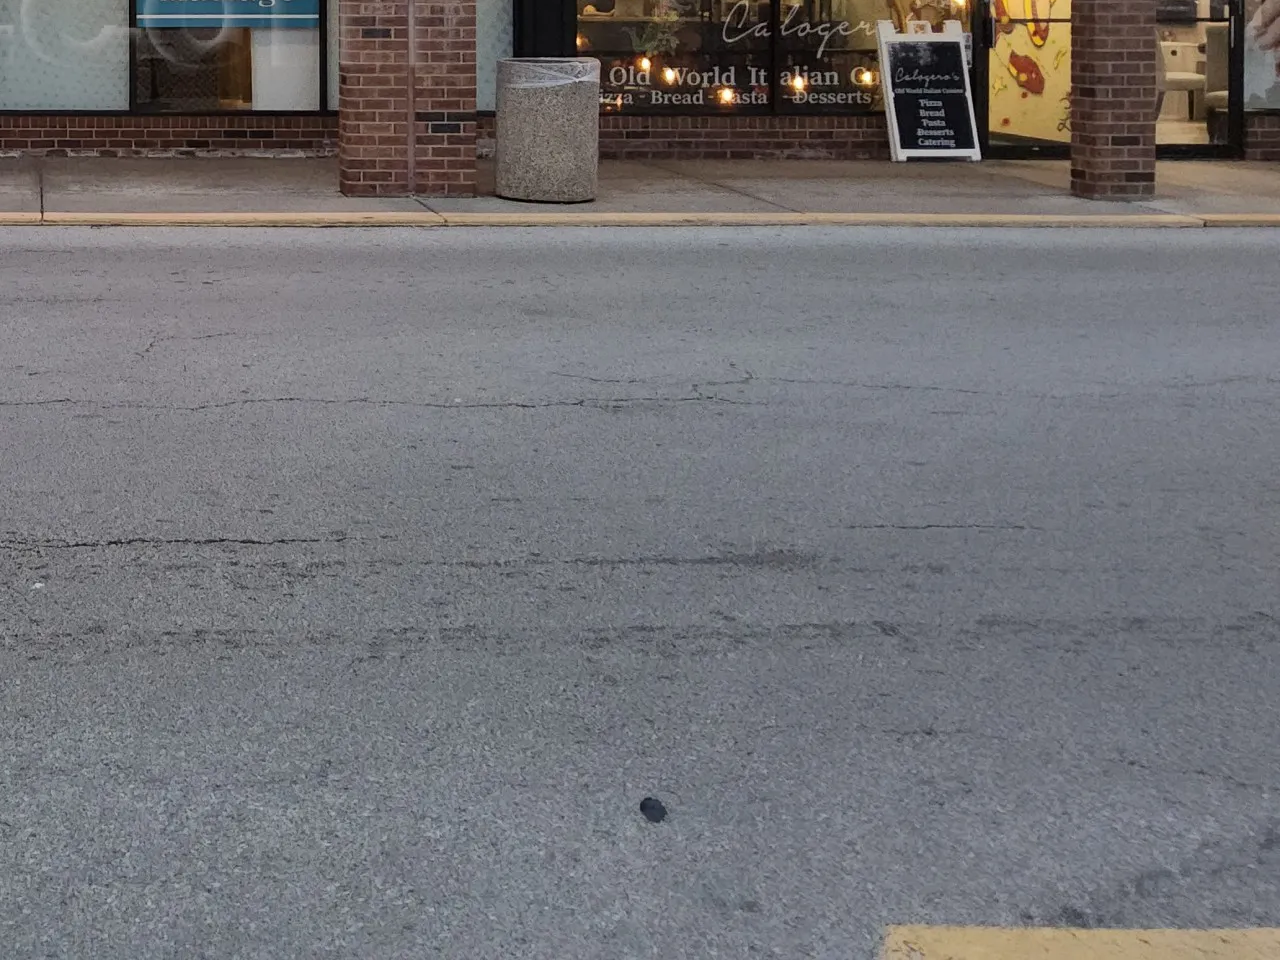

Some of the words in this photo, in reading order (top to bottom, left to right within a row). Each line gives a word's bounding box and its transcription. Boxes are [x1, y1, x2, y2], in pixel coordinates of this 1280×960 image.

[609, 64, 652, 86] Old
[599, 90, 634, 105] izza
[651, 90, 704, 105] Bread
[792, 90, 872, 105] Desserts
